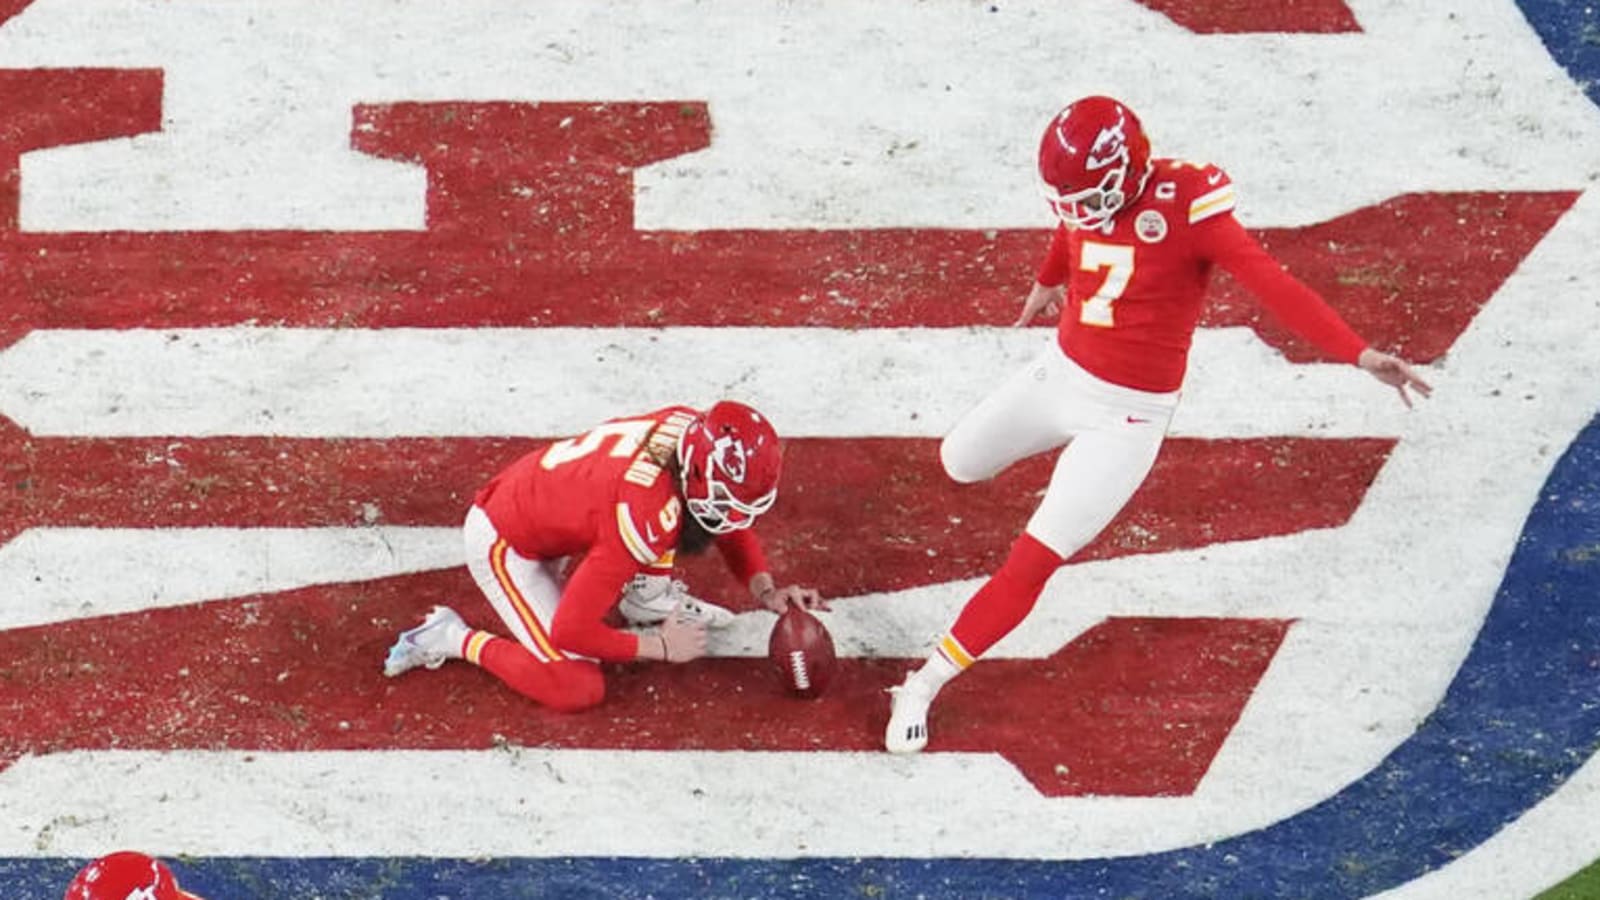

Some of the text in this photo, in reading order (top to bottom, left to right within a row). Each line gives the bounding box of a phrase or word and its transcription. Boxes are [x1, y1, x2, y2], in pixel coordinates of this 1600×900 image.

[1154, 181, 1177, 199] C
[1079, 240, 1135, 328] 7
[540, 419, 657, 471] 5
